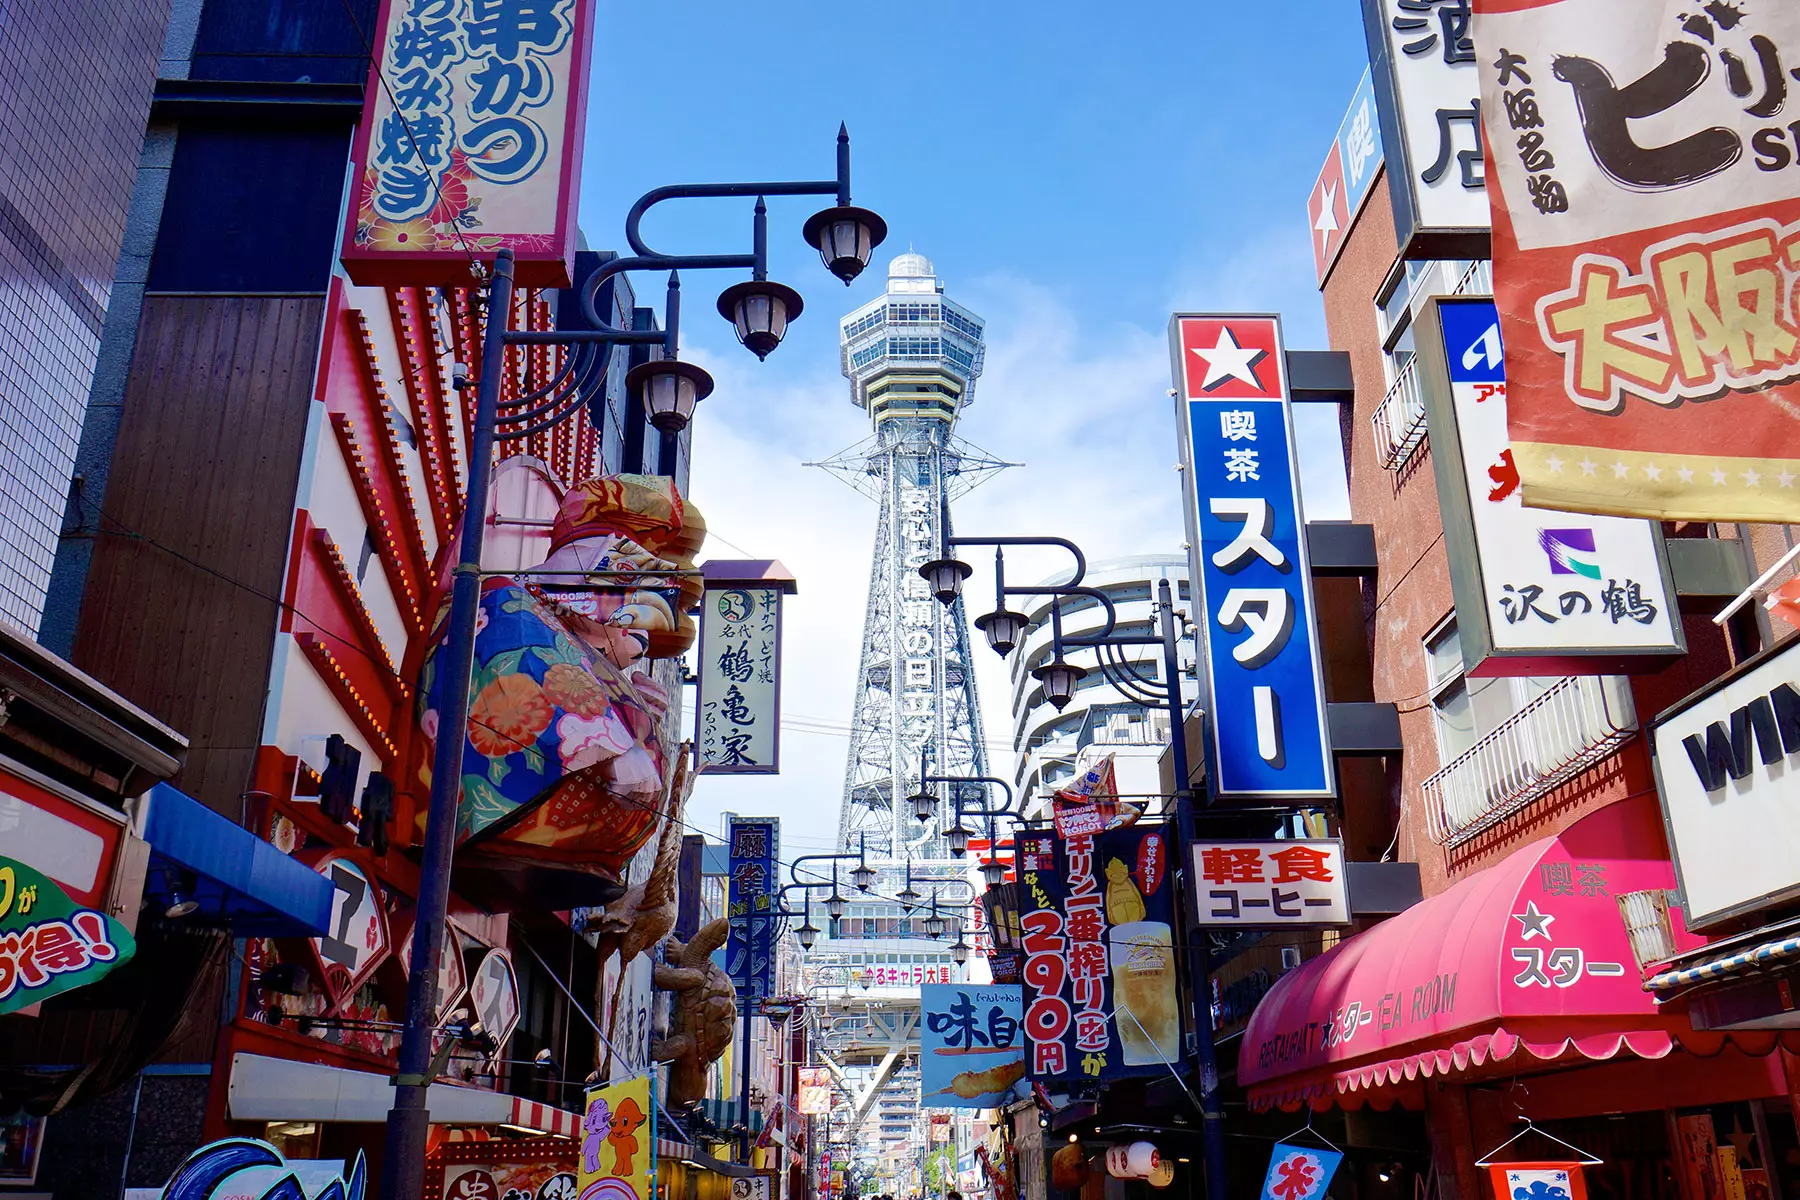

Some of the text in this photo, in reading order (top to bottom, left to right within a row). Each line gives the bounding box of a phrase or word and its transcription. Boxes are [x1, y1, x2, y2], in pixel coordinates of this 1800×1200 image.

[1551, 0, 1800, 193] ビリ
[1493, 47, 1569, 215] 大阪名物
[1548, 236, 1800, 395] 大阪
[758, 589, 777, 633] 串かつ
[1210, 409, 1290, 764] 喫茶 スター
[1499, 578, 1658, 626] 沢の鶴
[718, 623, 754, 640] 名代
[716, 639, 758, 767] 鶴亀家
[730, 825, 767, 895] 麻雀
[1201, 846, 1334, 885] 軽食
[1540, 862, 1610, 897] 喫茶
[1209, 887, 1332, 918] コーヒー
[1021, 908, 1072, 1076] 290円
[1511, 948, 1625, 989] スター
[926, 991, 1024, 1052] 味自
[1376, 972, 1457, 1034] TEA ROOM
